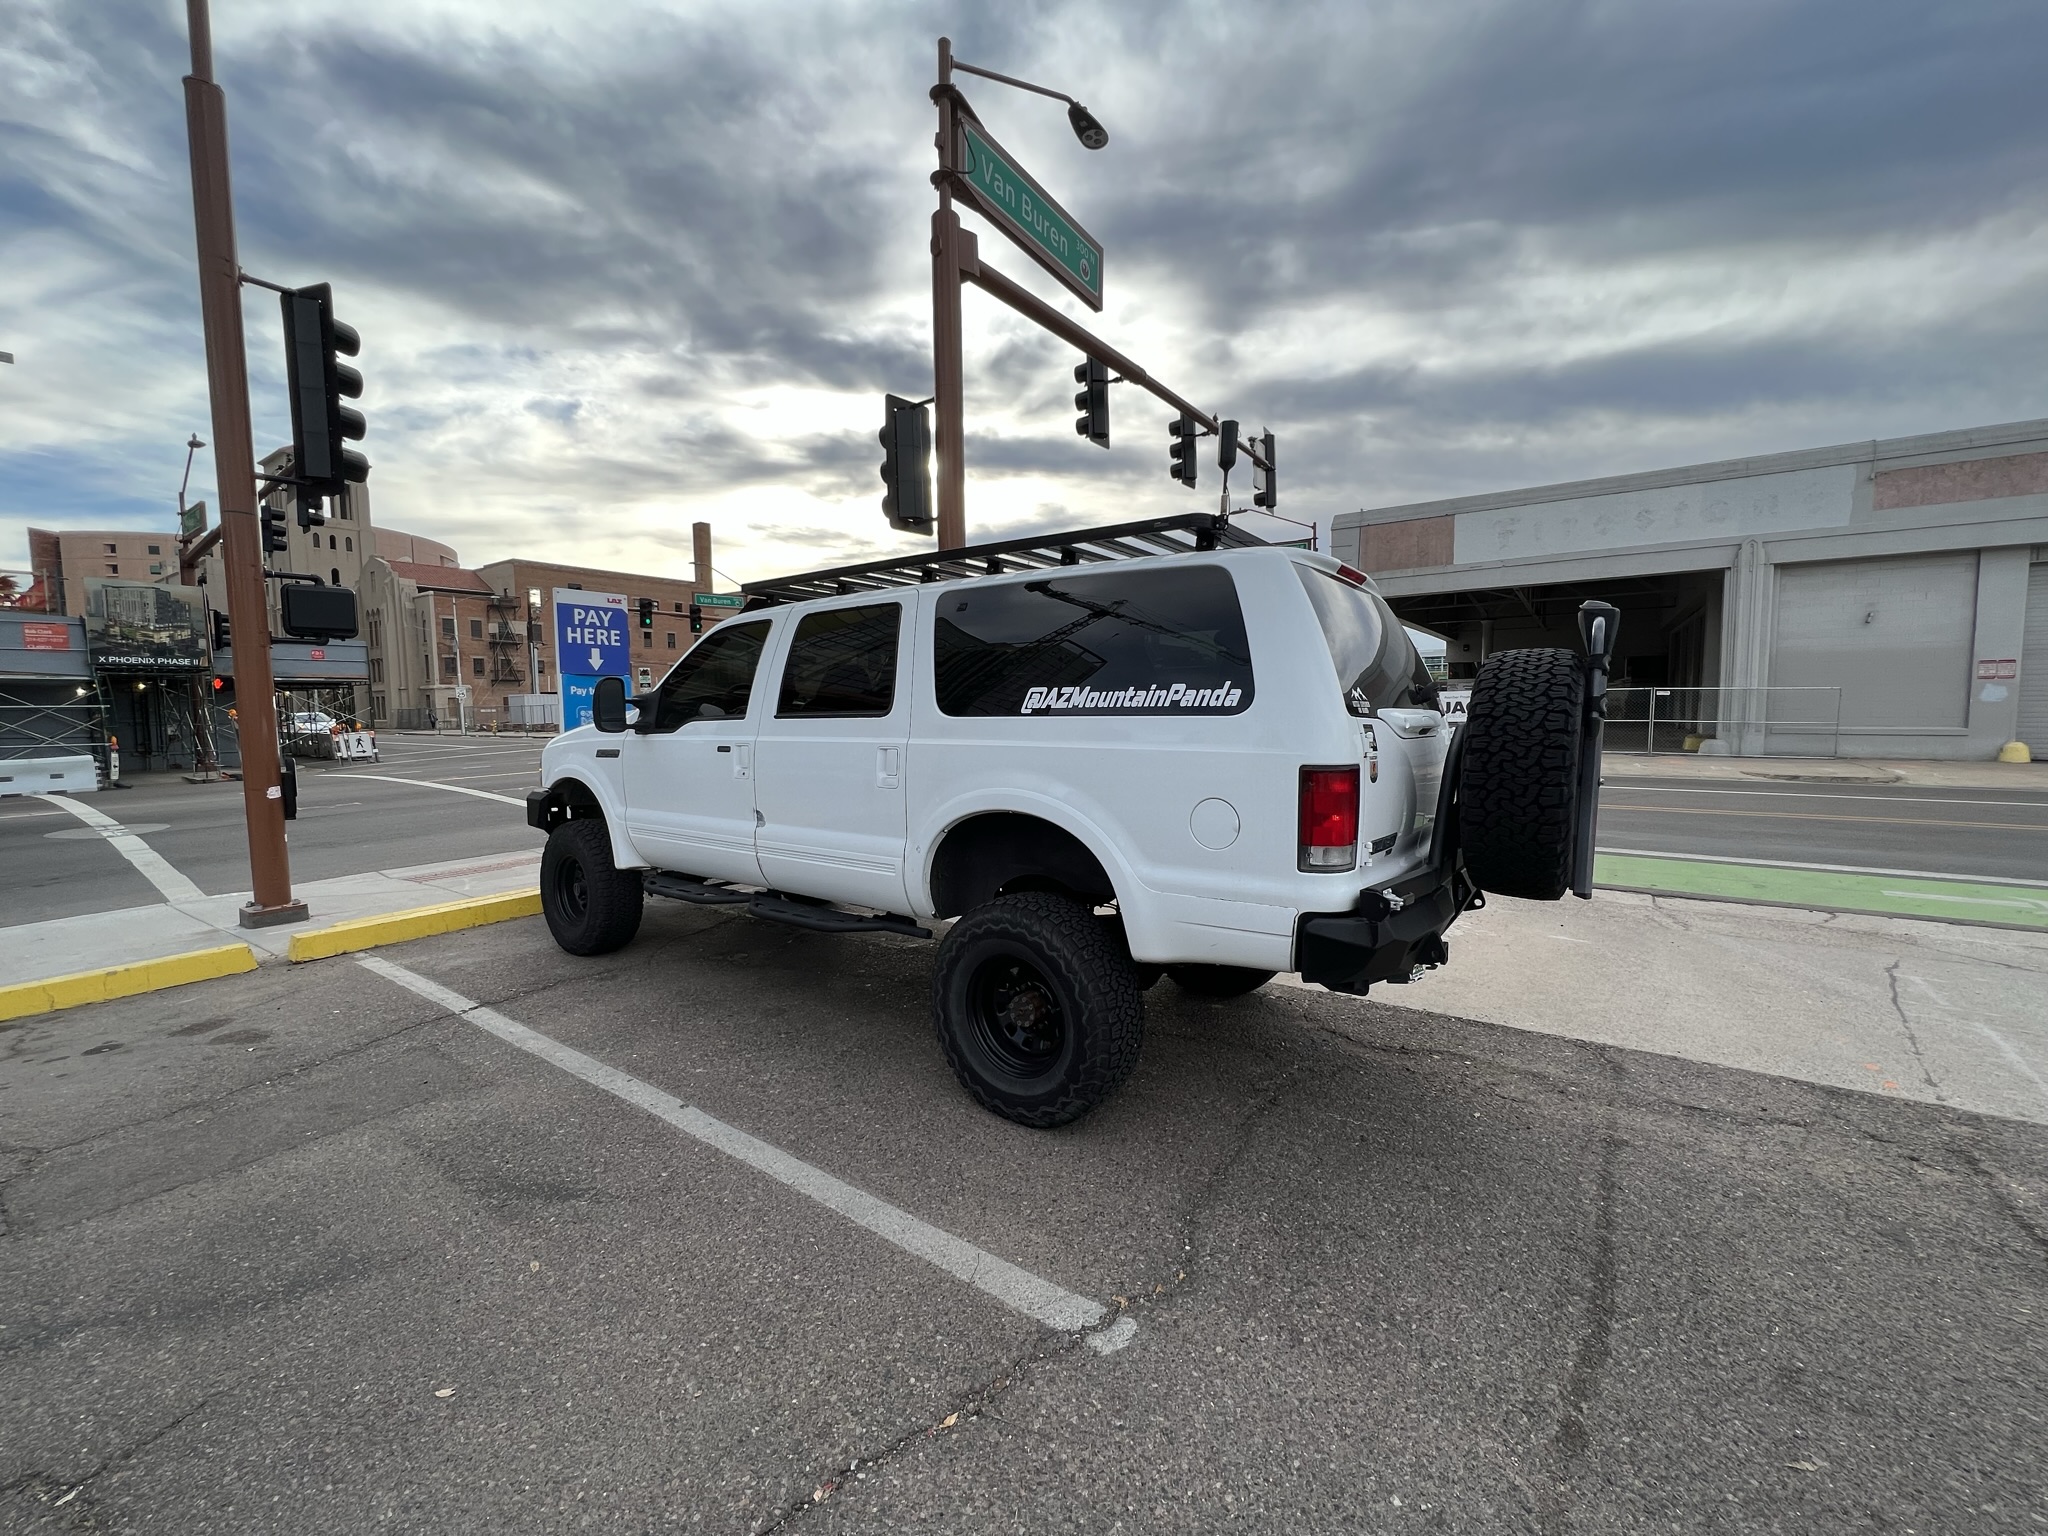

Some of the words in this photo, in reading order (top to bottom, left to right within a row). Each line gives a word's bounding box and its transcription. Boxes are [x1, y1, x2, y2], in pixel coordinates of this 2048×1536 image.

[981, 154, 1015, 208] Van
[1022, 193, 1068, 256] Buren
[712, 597, 732, 605] Buren
[573, 608, 613, 627] PAY
[567, 627, 621, 646] HERE
[98, 655, 106, 663] X
[108, 656, 156, 664] PHOENIX
[157, 657, 191, 666] PHASE
[570, 686, 587, 697] Pay
[1020, 680, 1242, 714] @AZMountainPanda
[1445, 702, 1467, 714] JA
